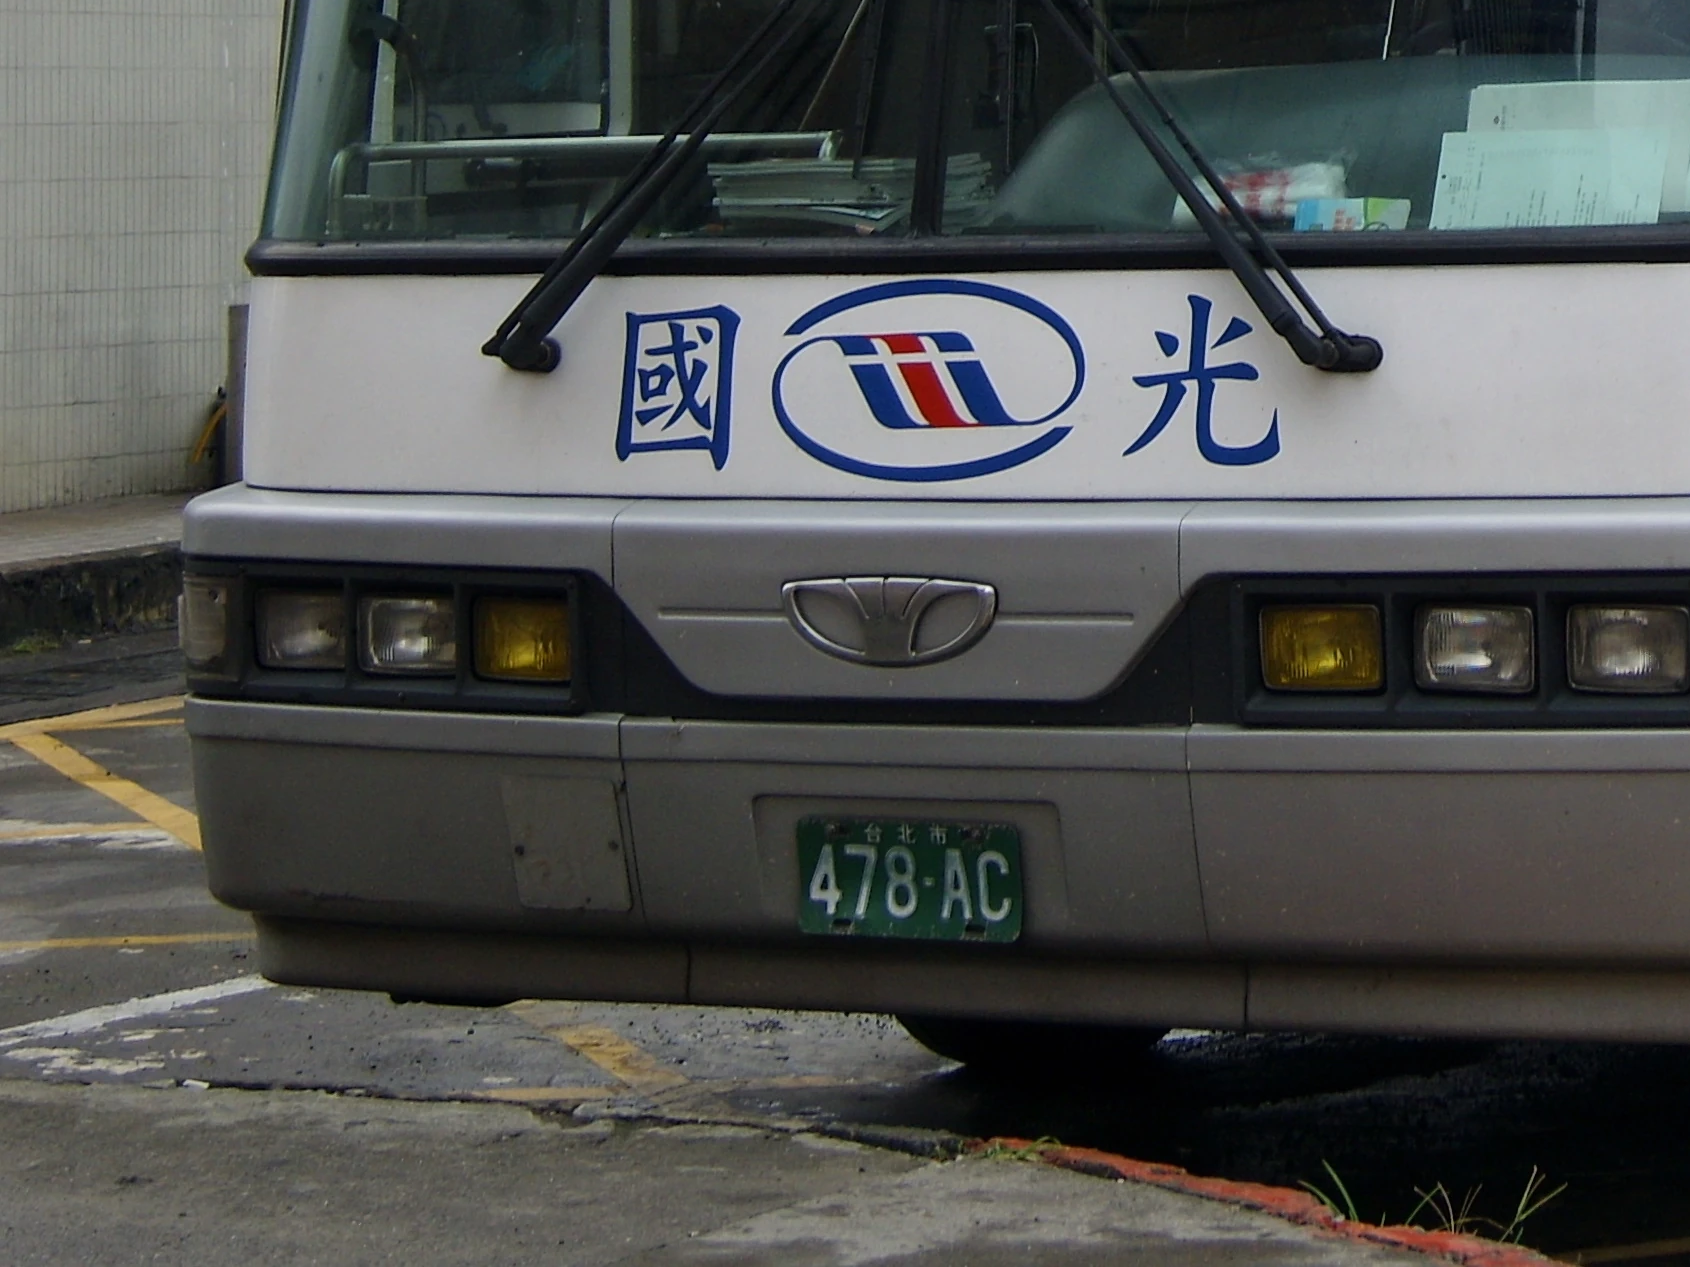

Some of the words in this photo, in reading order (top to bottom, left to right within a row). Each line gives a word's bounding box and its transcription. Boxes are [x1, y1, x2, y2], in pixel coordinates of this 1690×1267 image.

[864, 823, 948, 845] 台北市
[809, 843, 1012, 921] 478-AC
